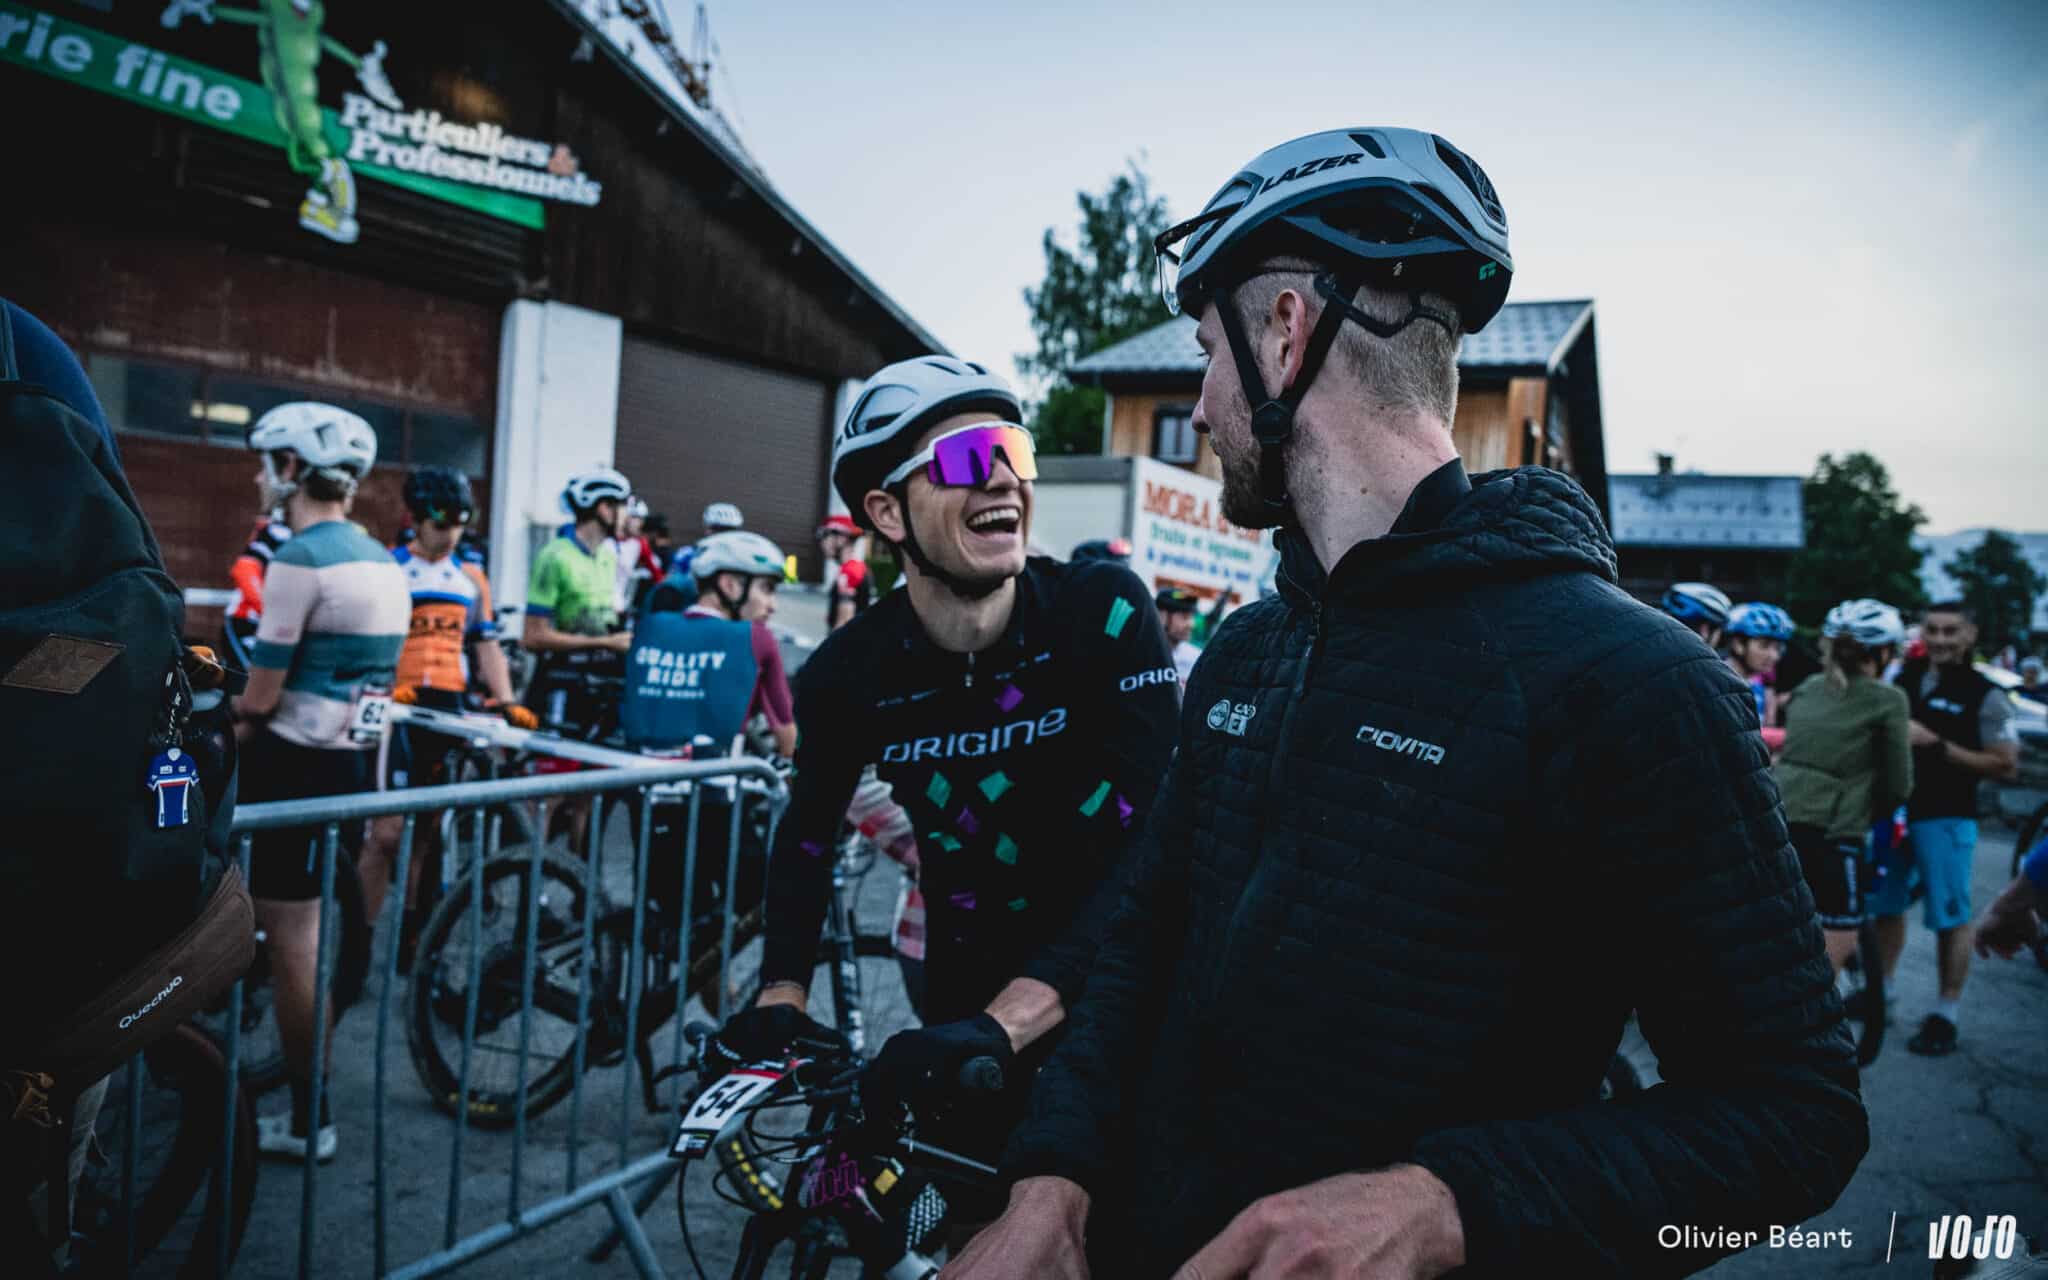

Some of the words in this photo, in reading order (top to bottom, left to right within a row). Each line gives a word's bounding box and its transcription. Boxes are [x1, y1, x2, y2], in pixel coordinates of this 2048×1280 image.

[113, 43, 242, 120] fine
[341, 93, 552, 166] Particuliers
[347, 128, 602, 207] Professionnels
[1260, 153, 1364, 194] LAZER
[1143, 480, 1211, 529] MORA
[635, 645, 727, 671] QUALITY
[646, 666, 699, 687] RIDE
[695, 1080, 760, 1119] 54
